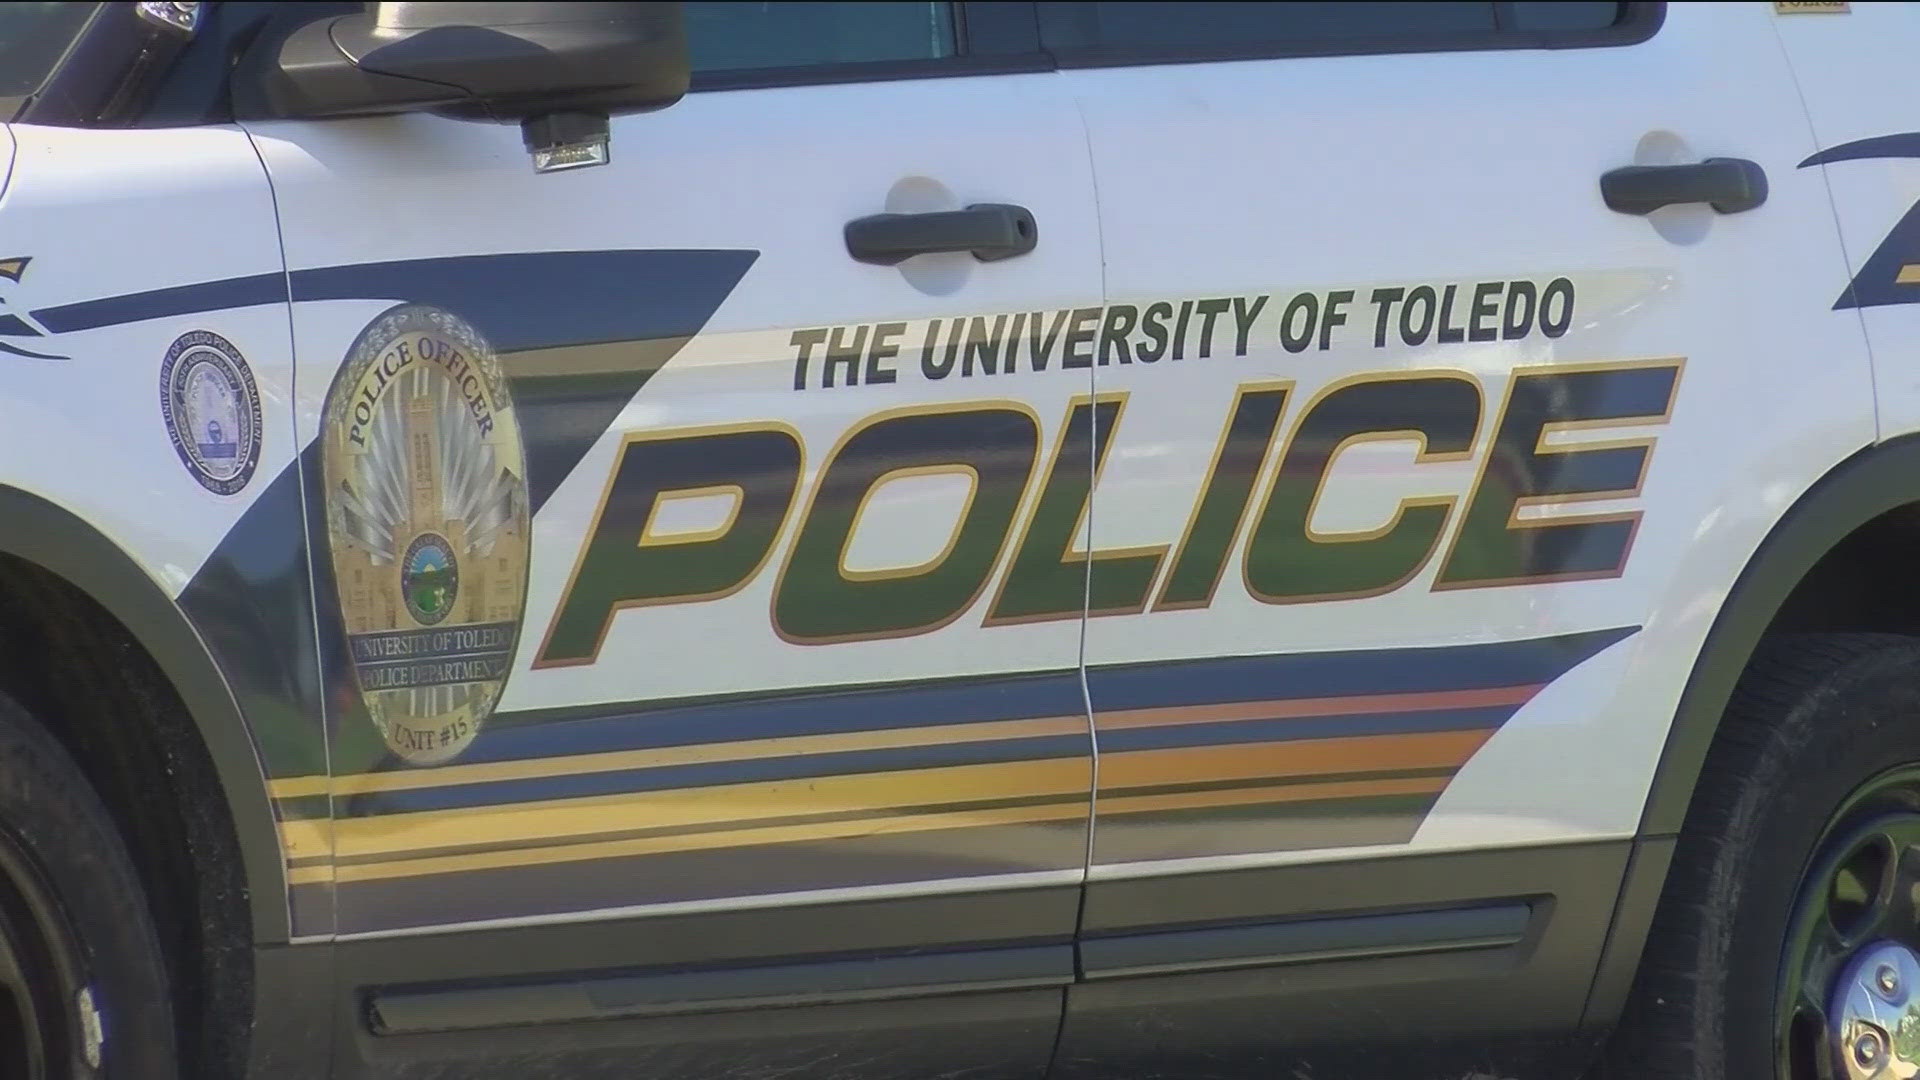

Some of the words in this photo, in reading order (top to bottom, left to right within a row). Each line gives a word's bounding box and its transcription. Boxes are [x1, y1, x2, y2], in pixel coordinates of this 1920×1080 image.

[790, 319, 907, 390] THE
[921, 295, 1268, 379] UNIVERSITY
[1280, 289, 1355, 353] OF
[1369, 276, 1575, 346] TOLEDO
[350, 341, 414, 448] POLICE
[418, 337, 494, 440] OFFICER
[531, 357, 1686, 669] POLICE
[355, 634, 432, 660] UNIVERSITY
[434, 631, 454, 652] OF
[363, 667, 410, 689] POLICE
[395, 724, 435, 751] UNIT
[440, 717, 469, 747] #15
